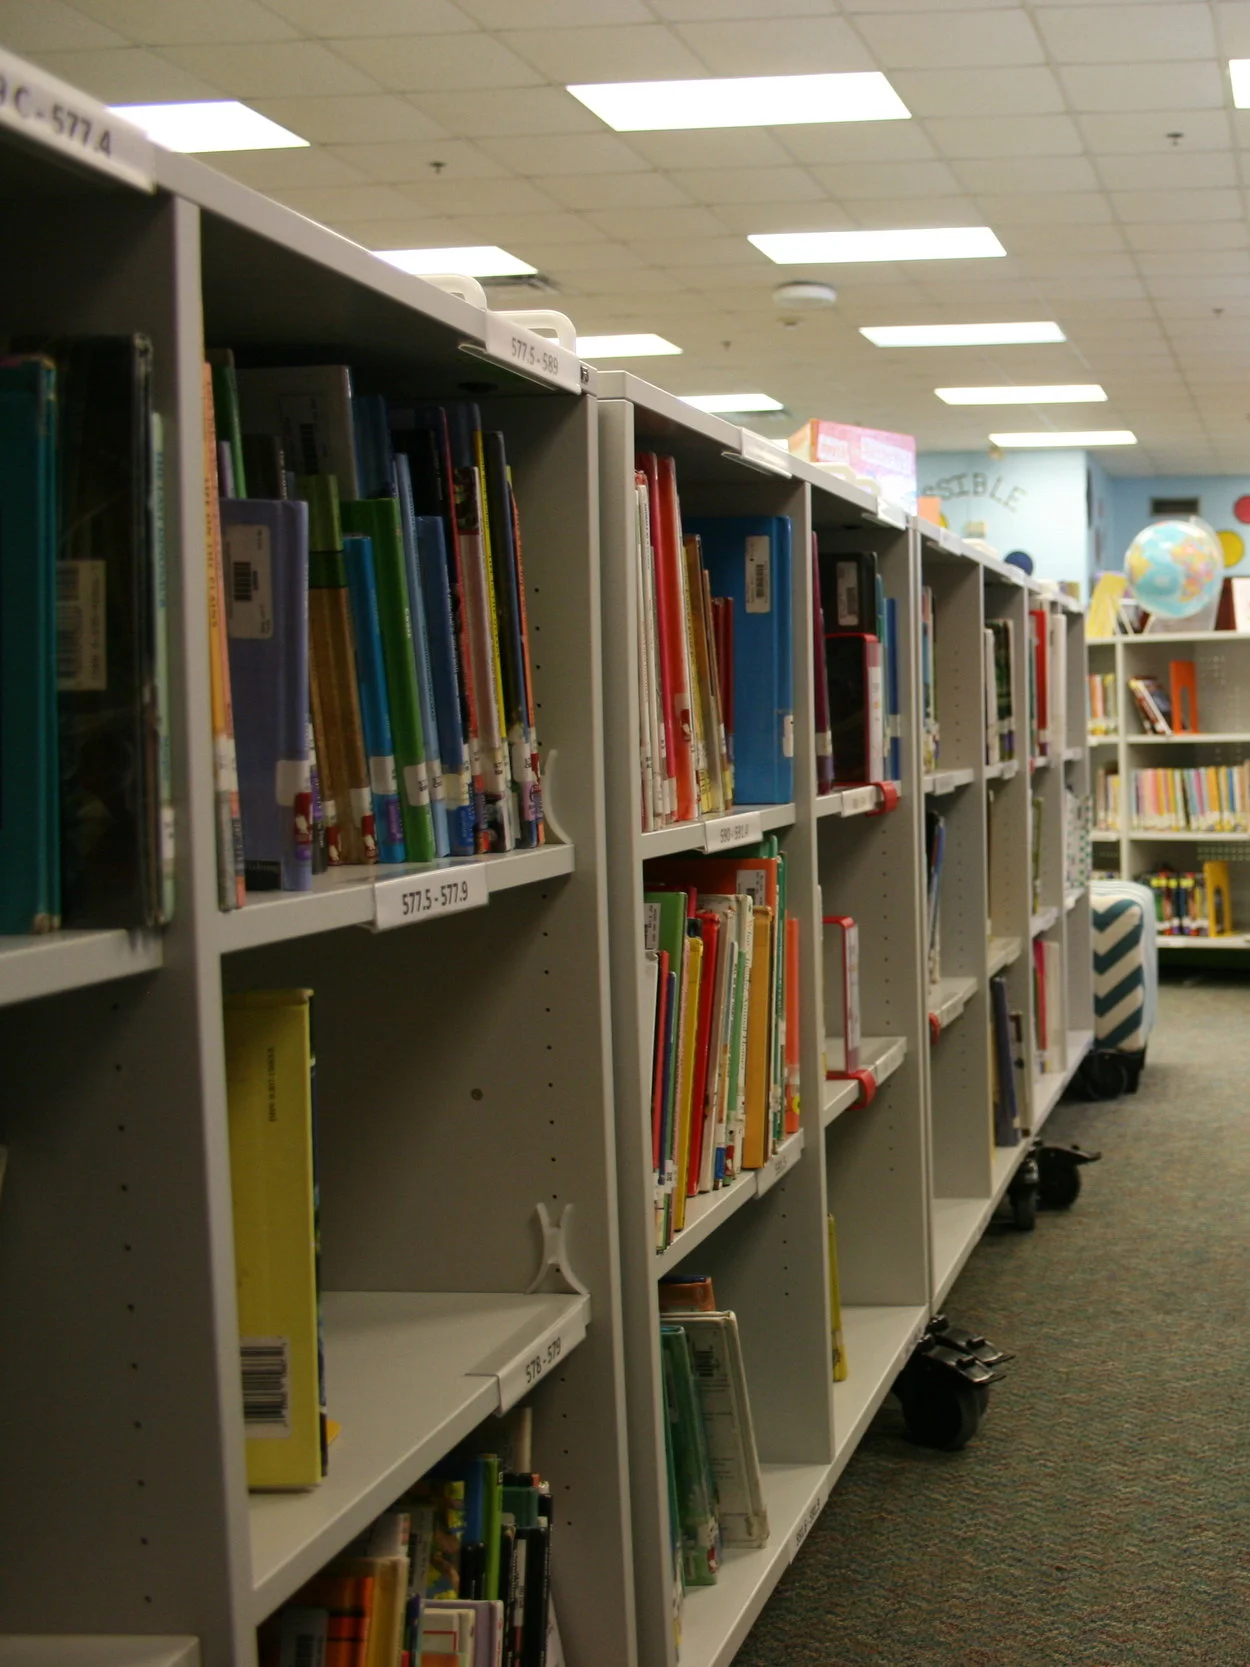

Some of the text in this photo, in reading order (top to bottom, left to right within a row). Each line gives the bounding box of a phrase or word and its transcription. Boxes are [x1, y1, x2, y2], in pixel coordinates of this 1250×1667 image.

[511, 336, 535, 366] 577.5
[542, 349, 559, 376] 589
[402, 888, 433, 916] 577.5
[440, 880, 469, 907] 577.9
[525, 1355, 542, 1385] 578
[547, 1336, 562, 1365] 579
